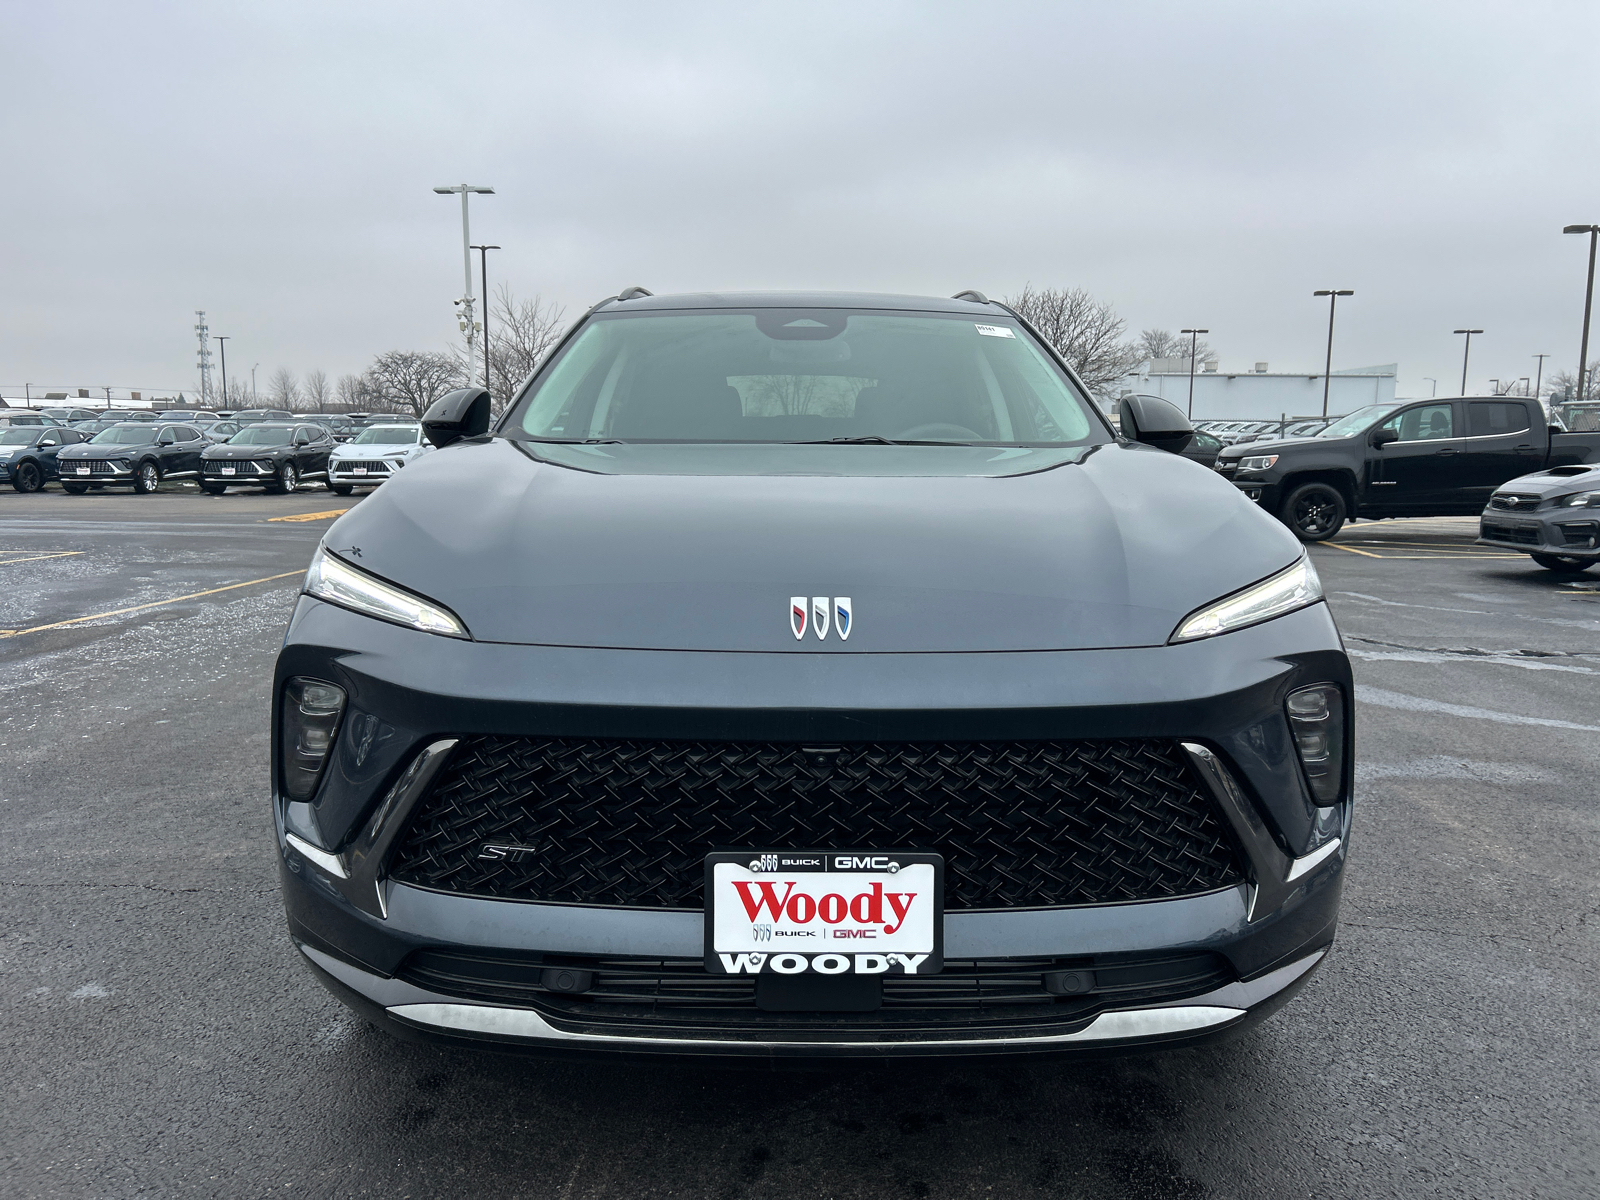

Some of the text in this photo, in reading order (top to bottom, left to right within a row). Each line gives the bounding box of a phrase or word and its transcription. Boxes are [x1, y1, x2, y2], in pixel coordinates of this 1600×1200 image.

[477, 845, 535, 862] ST
[835, 857, 888, 868] GMC
[731, 881, 917, 934] Woody
[833, 929, 877, 938] GMC
[719, 954, 929, 974] WOODY
